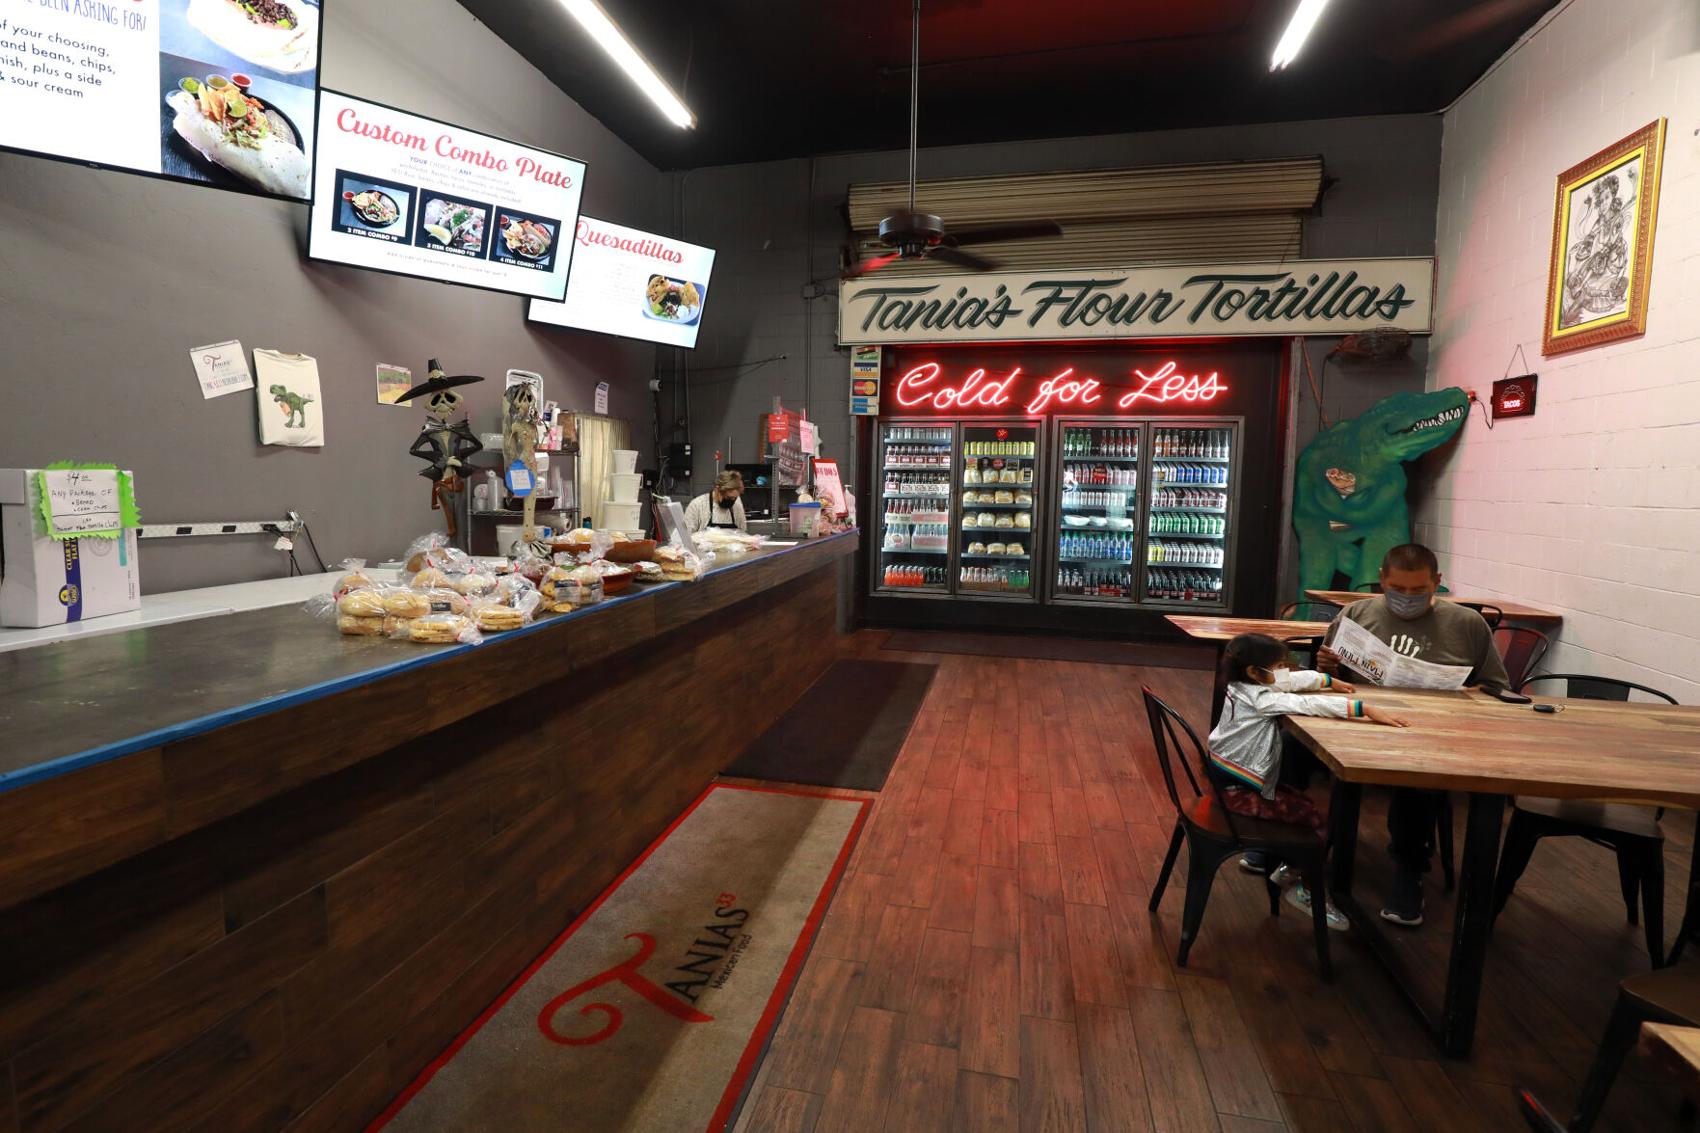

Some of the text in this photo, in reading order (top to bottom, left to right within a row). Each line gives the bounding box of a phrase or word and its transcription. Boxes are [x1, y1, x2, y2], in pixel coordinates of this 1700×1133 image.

[12, 25, 43, 38] your
[48, 33, 110, 57] choosing,
[1, 41, 116, 75] and beans, chips,
[33, 63, 59, 77] plus
[77, 73, 102, 86] side
[11, 75, 39, 88] sour
[44, 83, 84, 98] cream
[337, 107, 429, 152] Custom
[434, 134, 508, 172] Combo
[516, 157, 573, 189] Plate
[410, 156, 428, 166] YOUR
[353, 228, 367, 236] ITEM
[368, 231, 390, 240] COMBO
[576, 219, 684, 264] Quesadillas
[445, 246, 466, 255] COMBO
[517, 260, 535, 268] COMBO
[849, 270, 1416, 333] Tania's Flour Tortillas
[896, 361, 1228, 414] Cold for Less
[1503, 399, 1521, 409] TACOS
